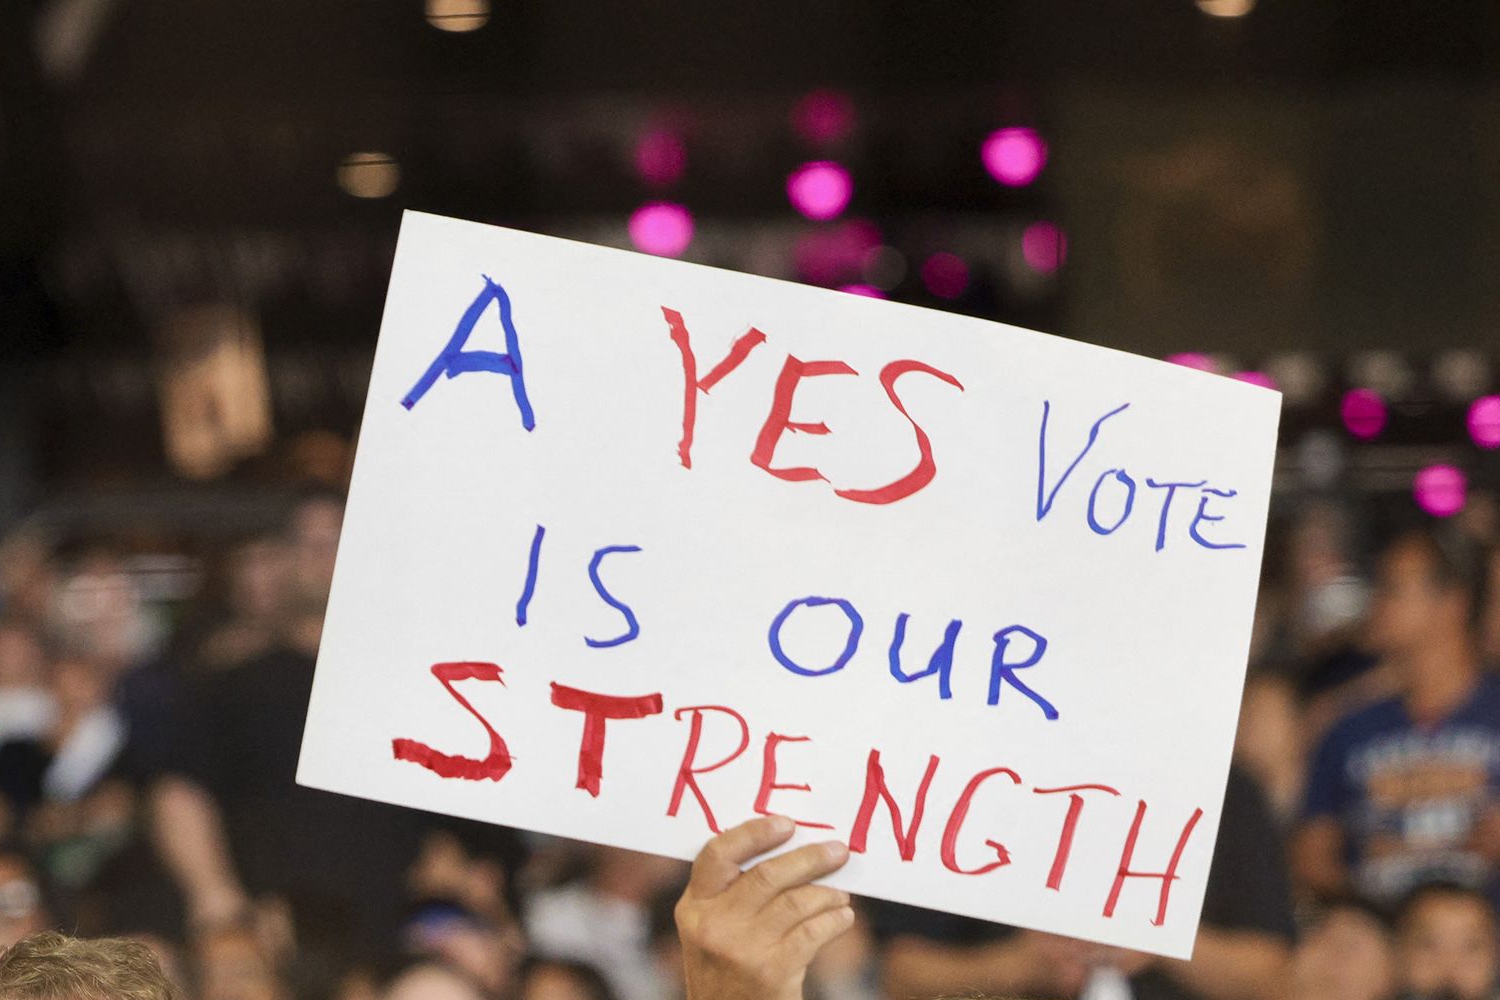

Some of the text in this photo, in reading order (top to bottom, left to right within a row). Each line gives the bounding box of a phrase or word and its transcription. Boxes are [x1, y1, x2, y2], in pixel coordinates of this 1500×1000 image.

[399, 273, 1248, 552] A YES VOTE
[515, 524, 1060, 721] IS OUR
[391, 660, 1204, 928] STRENGTH
